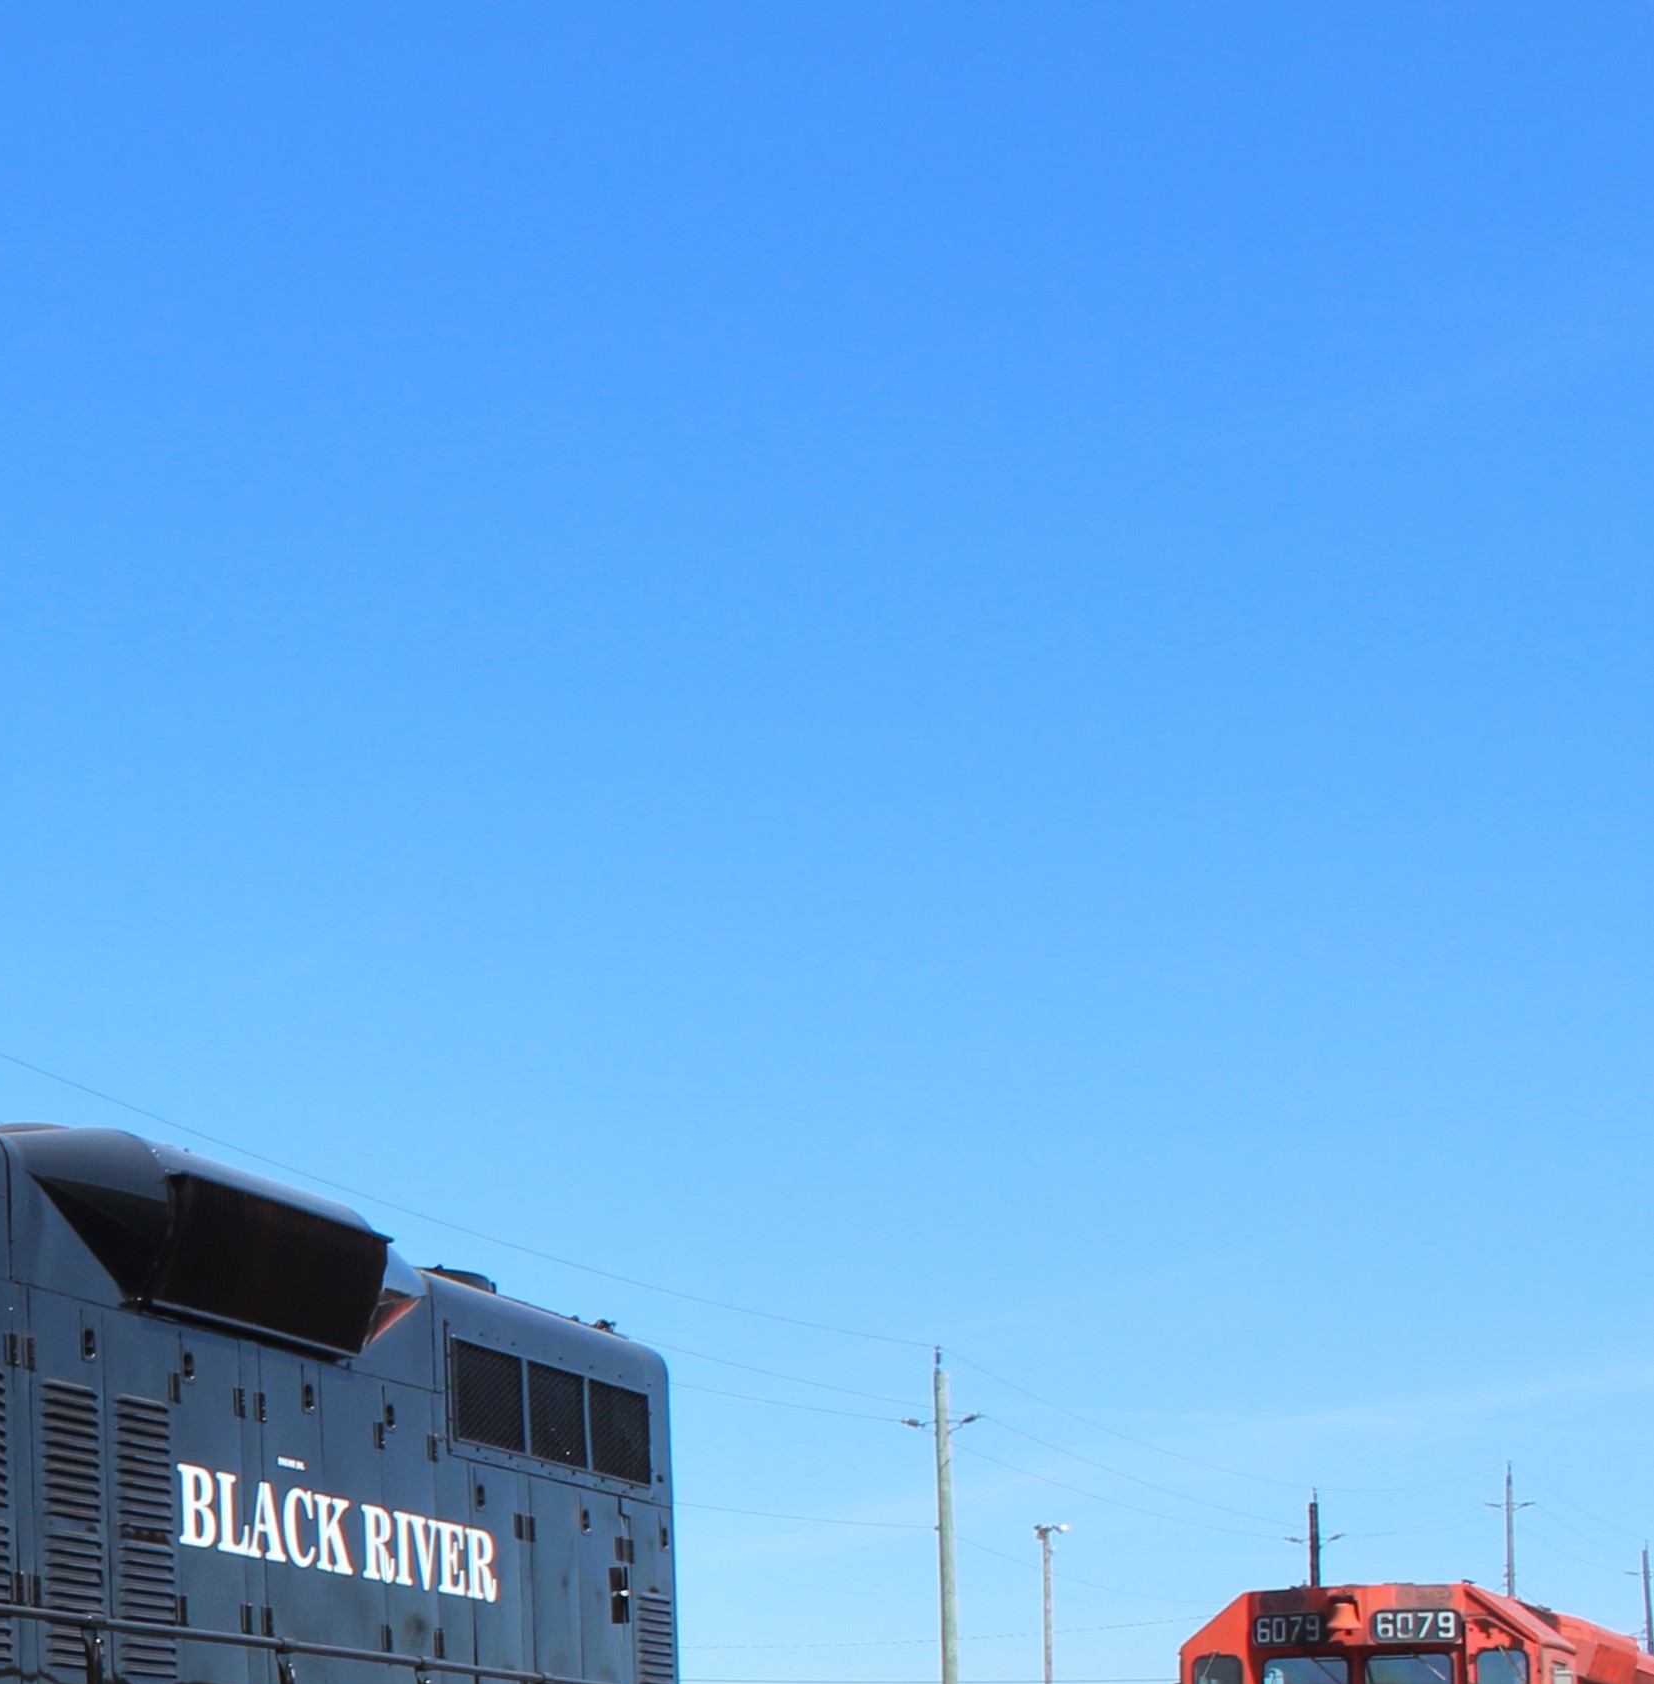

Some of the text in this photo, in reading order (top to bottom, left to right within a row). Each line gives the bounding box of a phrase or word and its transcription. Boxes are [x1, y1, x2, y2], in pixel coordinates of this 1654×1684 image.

[176, 1463, 498, 1603] BLACK RIVER
[1256, 1615, 1320, 1643] 6079
[1377, 1611, 1456, 1639] 6079
